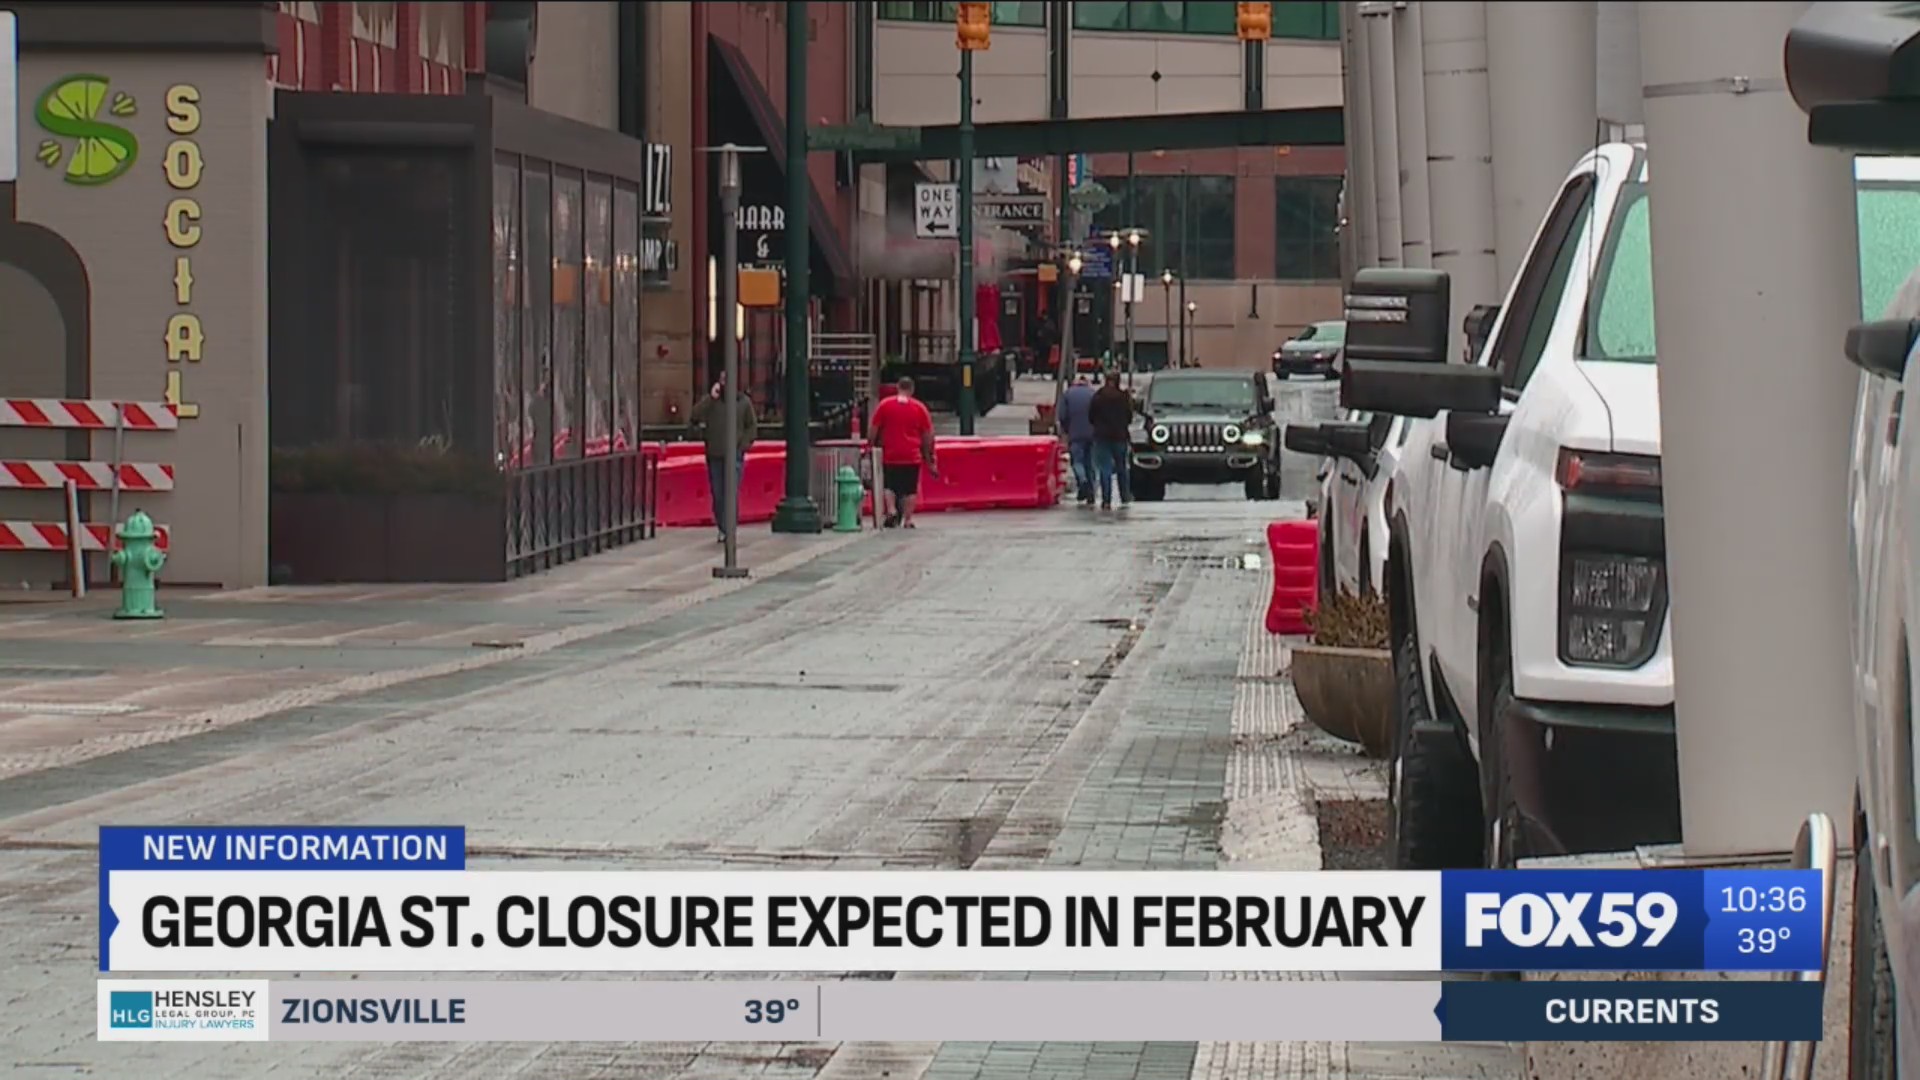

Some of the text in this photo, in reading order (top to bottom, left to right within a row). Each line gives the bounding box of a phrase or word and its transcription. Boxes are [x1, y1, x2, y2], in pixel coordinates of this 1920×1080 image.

[920, 189, 951, 201] ONE
[734, 205, 785, 230] HARR
[920, 206, 953, 218] WAY
[973, 203, 1042, 219] NTRANCE
[163, 84, 204, 418] SOCIAL
[756, 234, 770, 258] &
